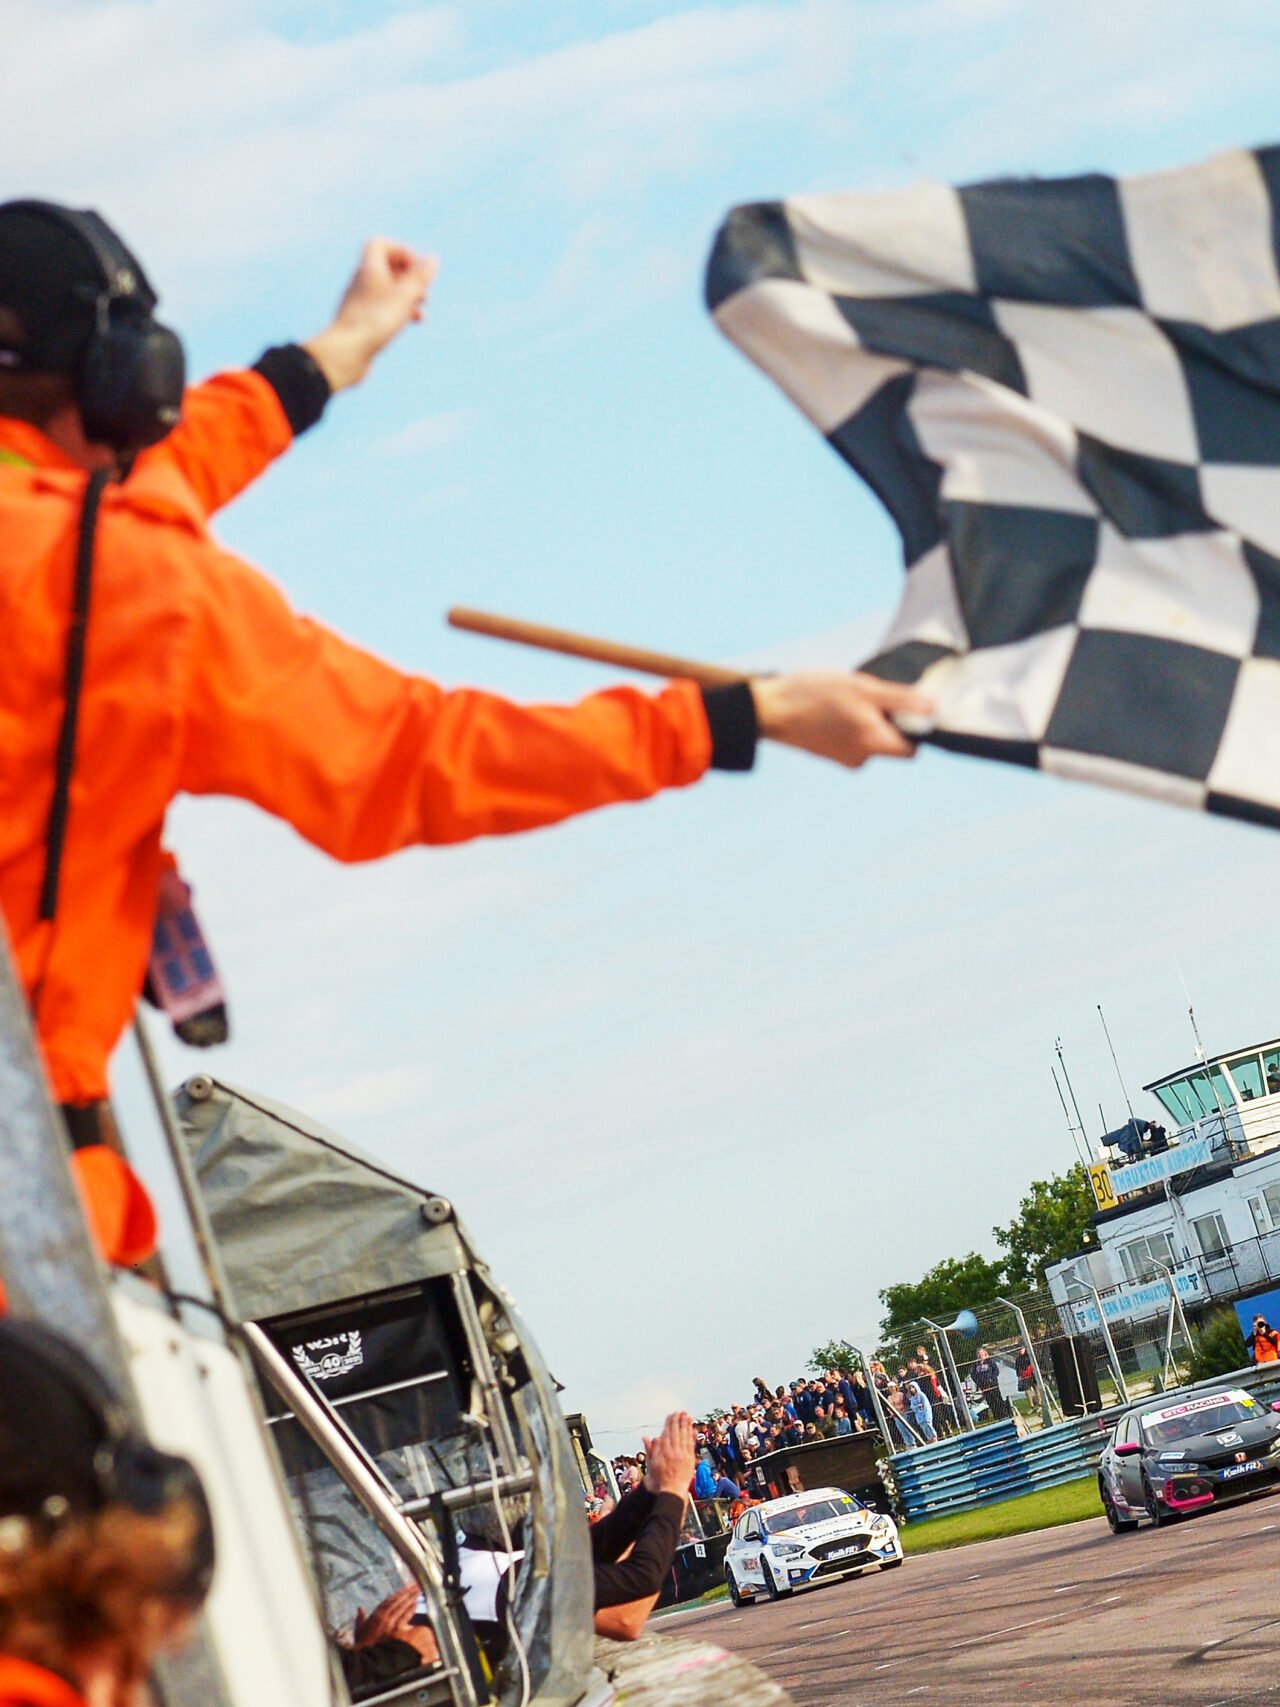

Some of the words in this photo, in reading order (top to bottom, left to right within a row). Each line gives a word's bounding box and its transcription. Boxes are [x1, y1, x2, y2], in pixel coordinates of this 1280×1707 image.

[1091, 1169, 1114, 1203] 30
[1111, 1159, 1166, 1193] THRUXTON
[323, 1357, 341, 1369] 40
